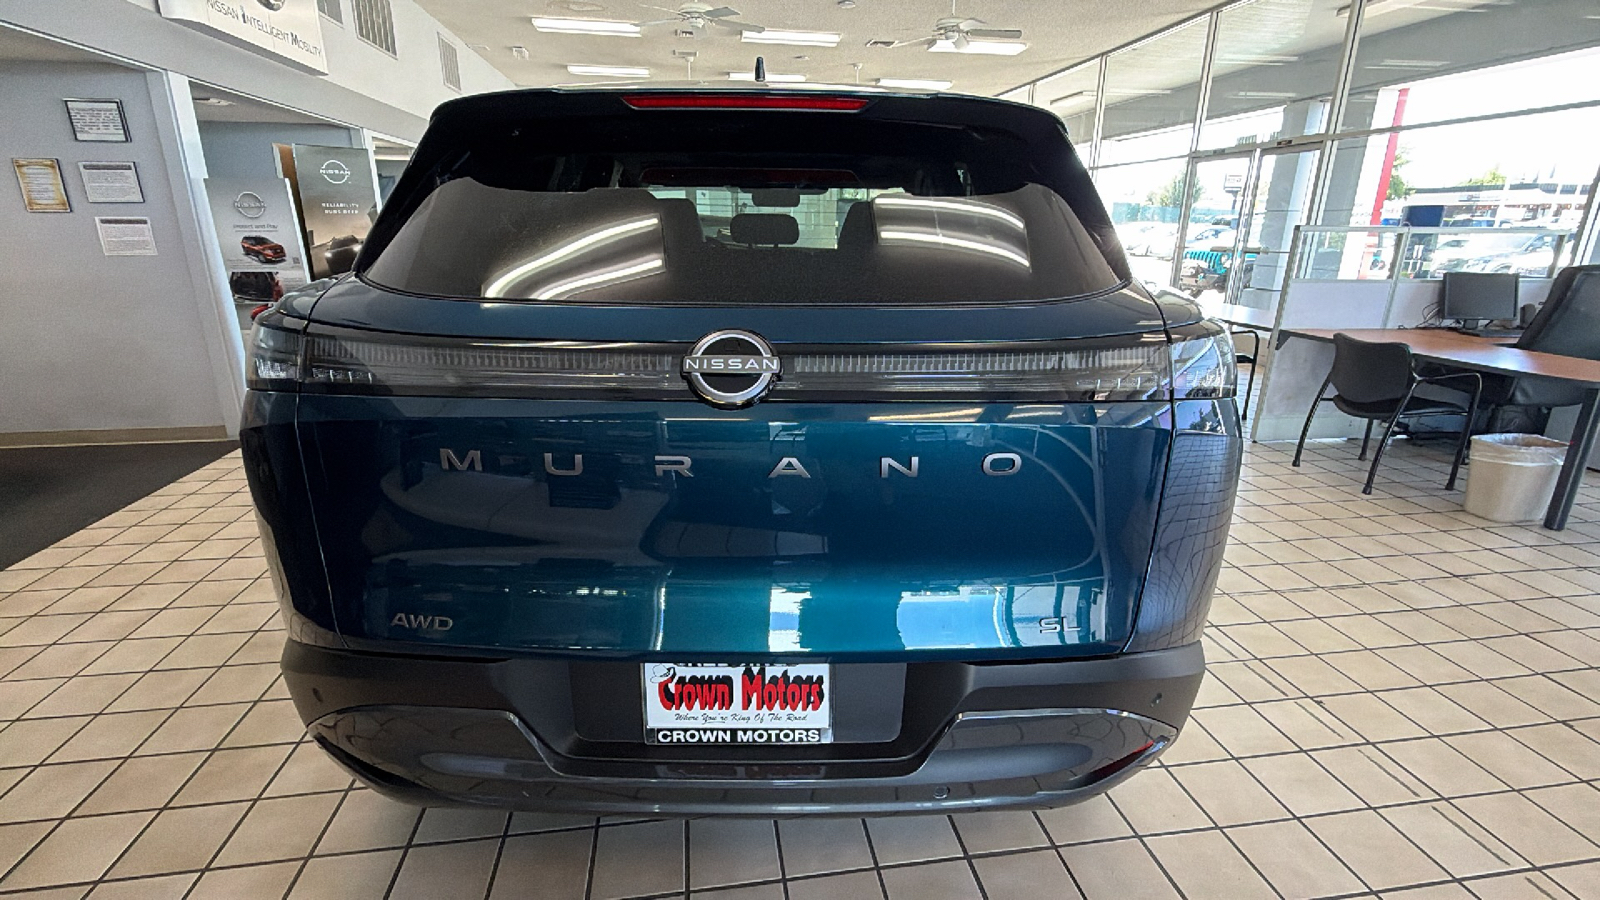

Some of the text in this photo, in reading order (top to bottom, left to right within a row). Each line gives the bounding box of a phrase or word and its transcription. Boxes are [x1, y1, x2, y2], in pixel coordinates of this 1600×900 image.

[206, 0, 321, 57] NISSAN INTELLIGENT MOBILITY
[686, 358, 777, 369] NISSAN
[440, 448, 1022, 478] MURANO
[391, 612, 454, 631] AWD
[1039, 616, 1081, 633] SL
[658, 666, 825, 711] Crown Motors
[674, 712, 807, 725] Where You're King Of The Road
[658, 730, 820, 743] CROWN MOTORS
